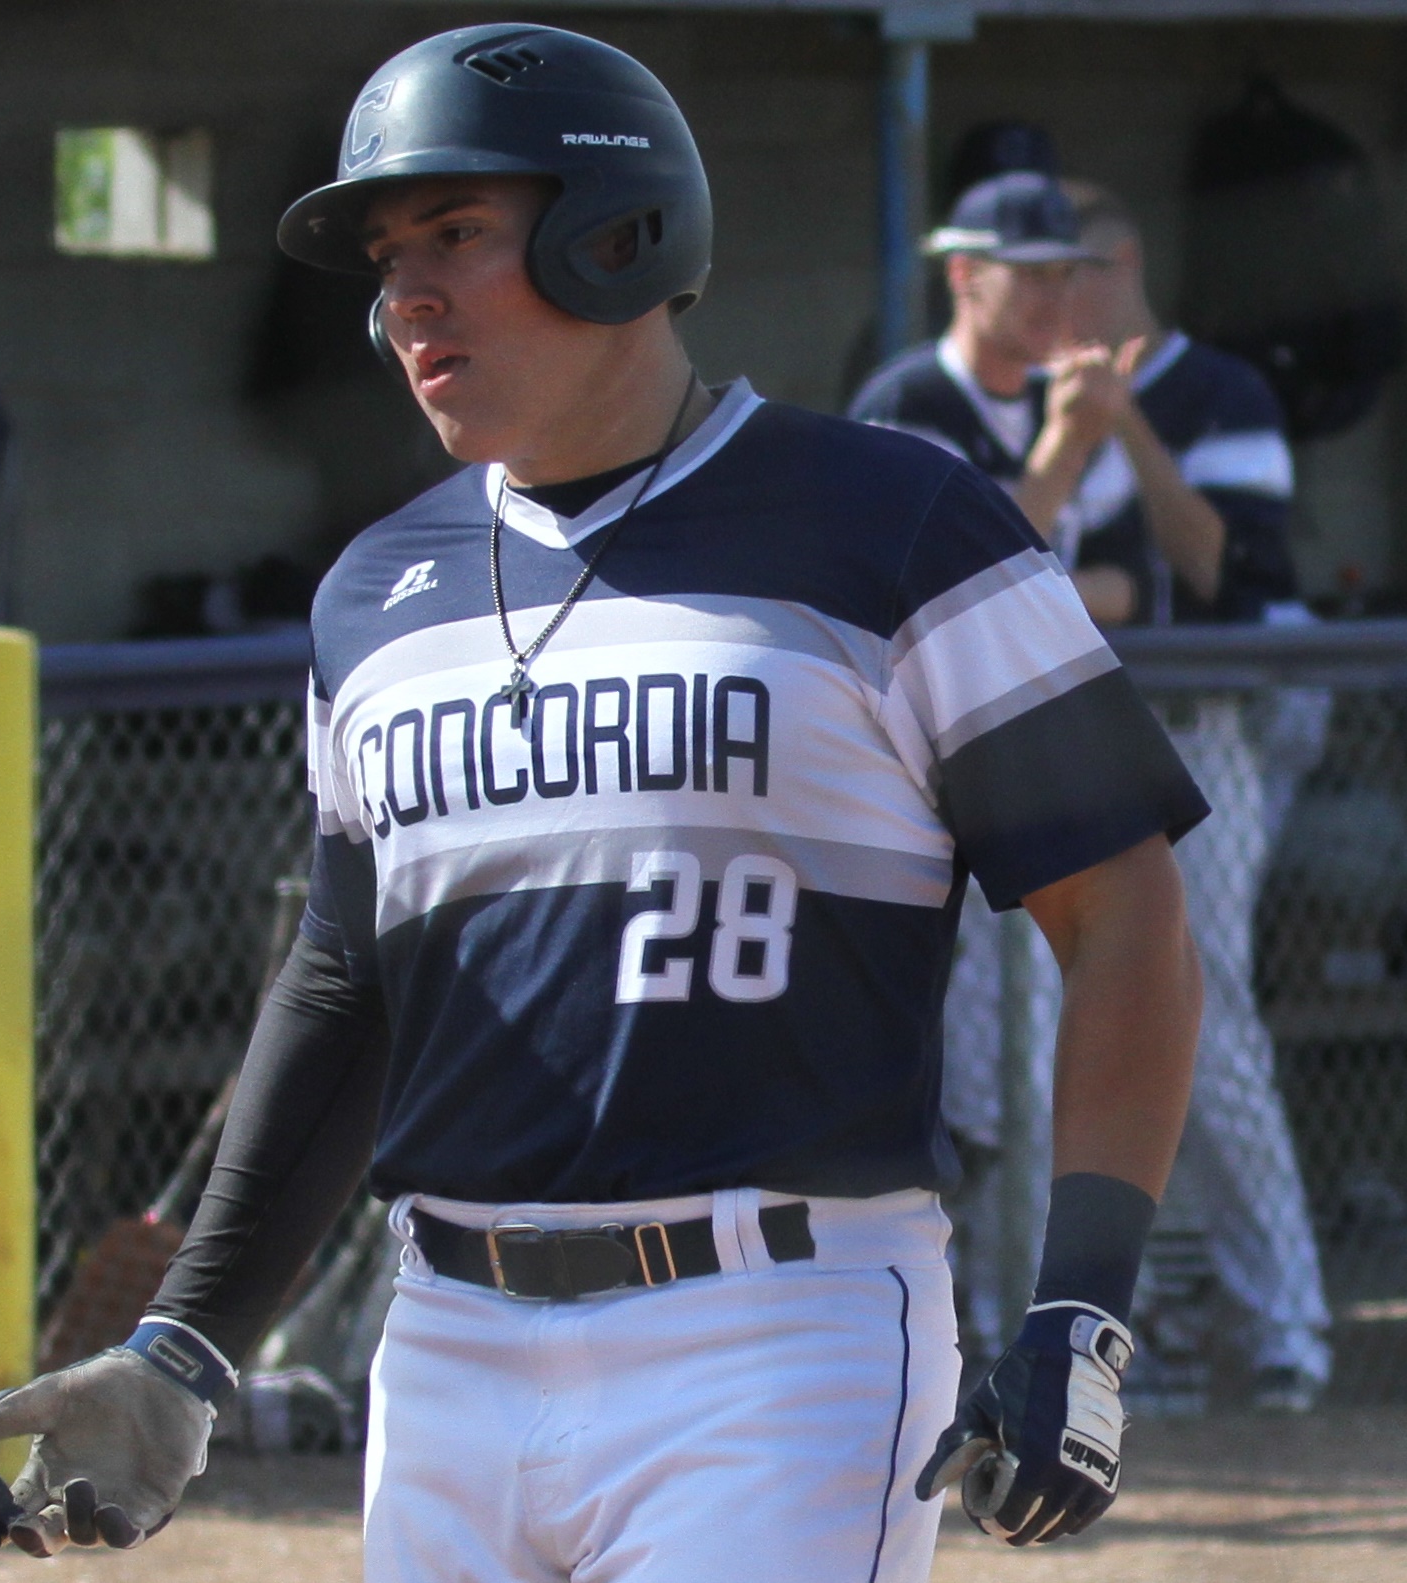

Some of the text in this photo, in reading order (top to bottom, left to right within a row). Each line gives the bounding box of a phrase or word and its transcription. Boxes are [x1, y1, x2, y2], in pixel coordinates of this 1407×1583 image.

[561, 133, 651, 148] RAWLINGS
[382, 578, 439, 612] RUSSELL
[357, 672, 771, 839] CONCORDIA
[614, 850, 800, 1004] 28
